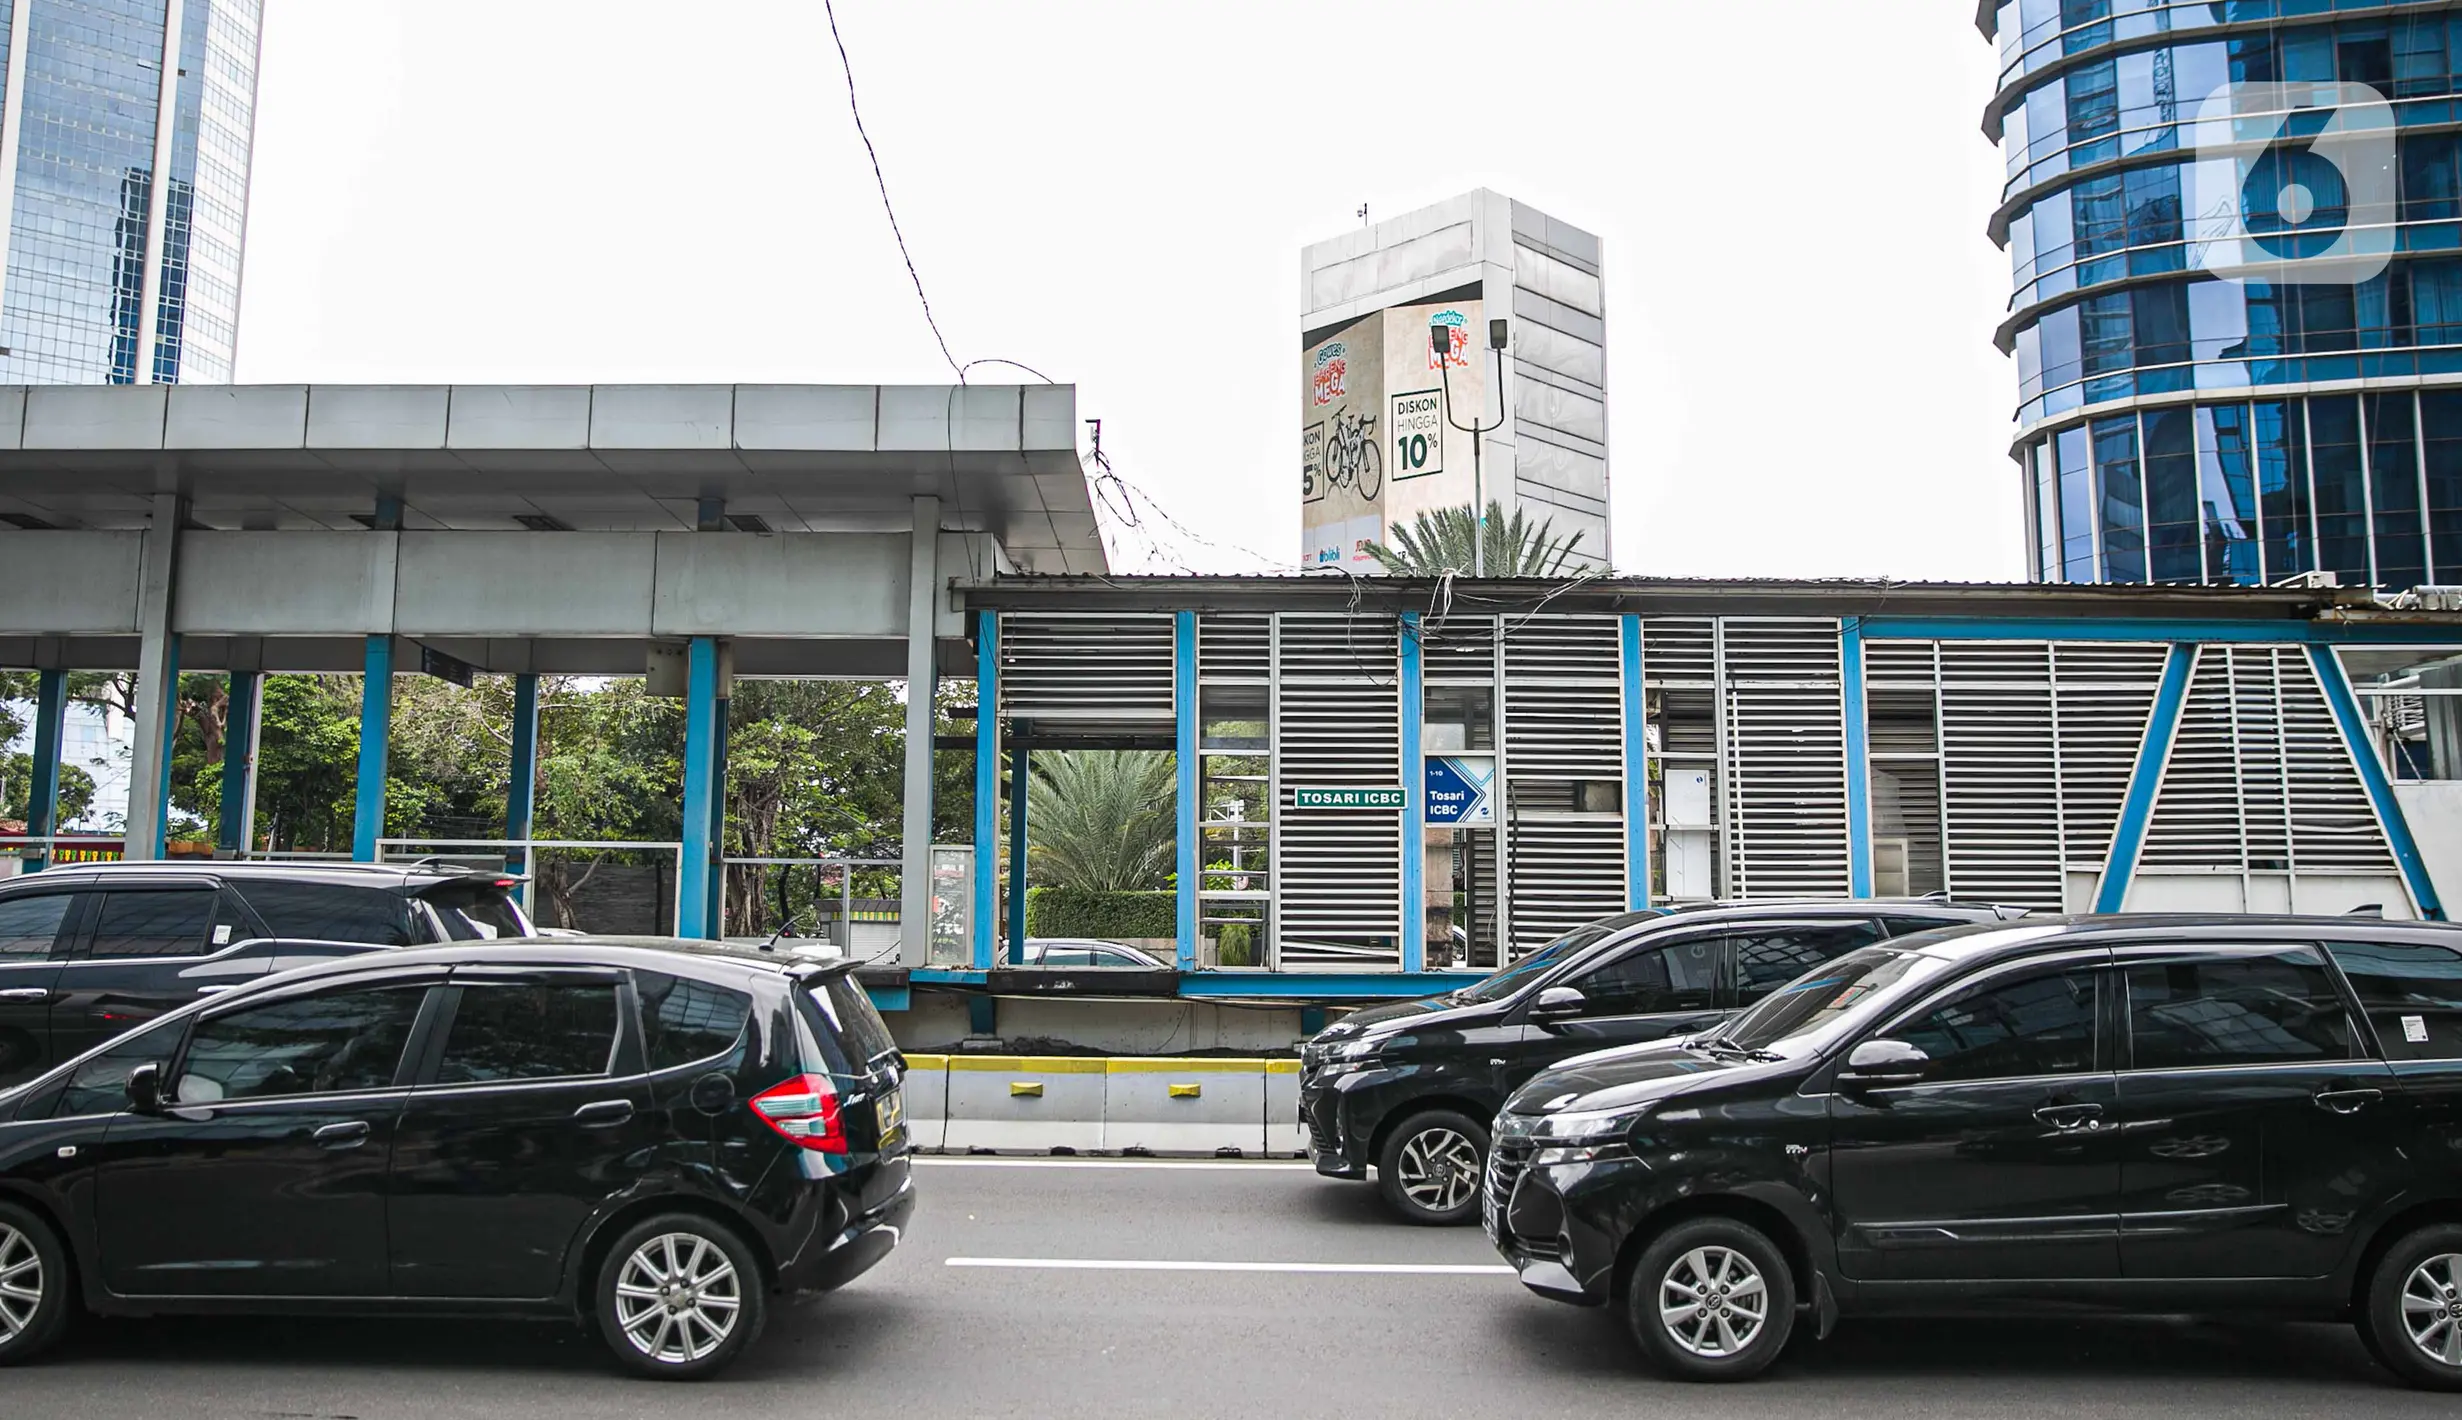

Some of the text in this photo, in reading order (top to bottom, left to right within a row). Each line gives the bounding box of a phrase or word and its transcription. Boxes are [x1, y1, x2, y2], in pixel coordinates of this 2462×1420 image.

[1314, 372, 1346, 406] MEGA
[1398, 398, 1437, 415] DISKON
[1397, 414, 1438, 433] HINGGA
[1398, 432, 1438, 471] 10%
[1301, 792, 1401, 804] TOSARI ICBC
[1429, 790, 1465, 801] Tosari
[1430, 805, 1458, 815] ICBC
